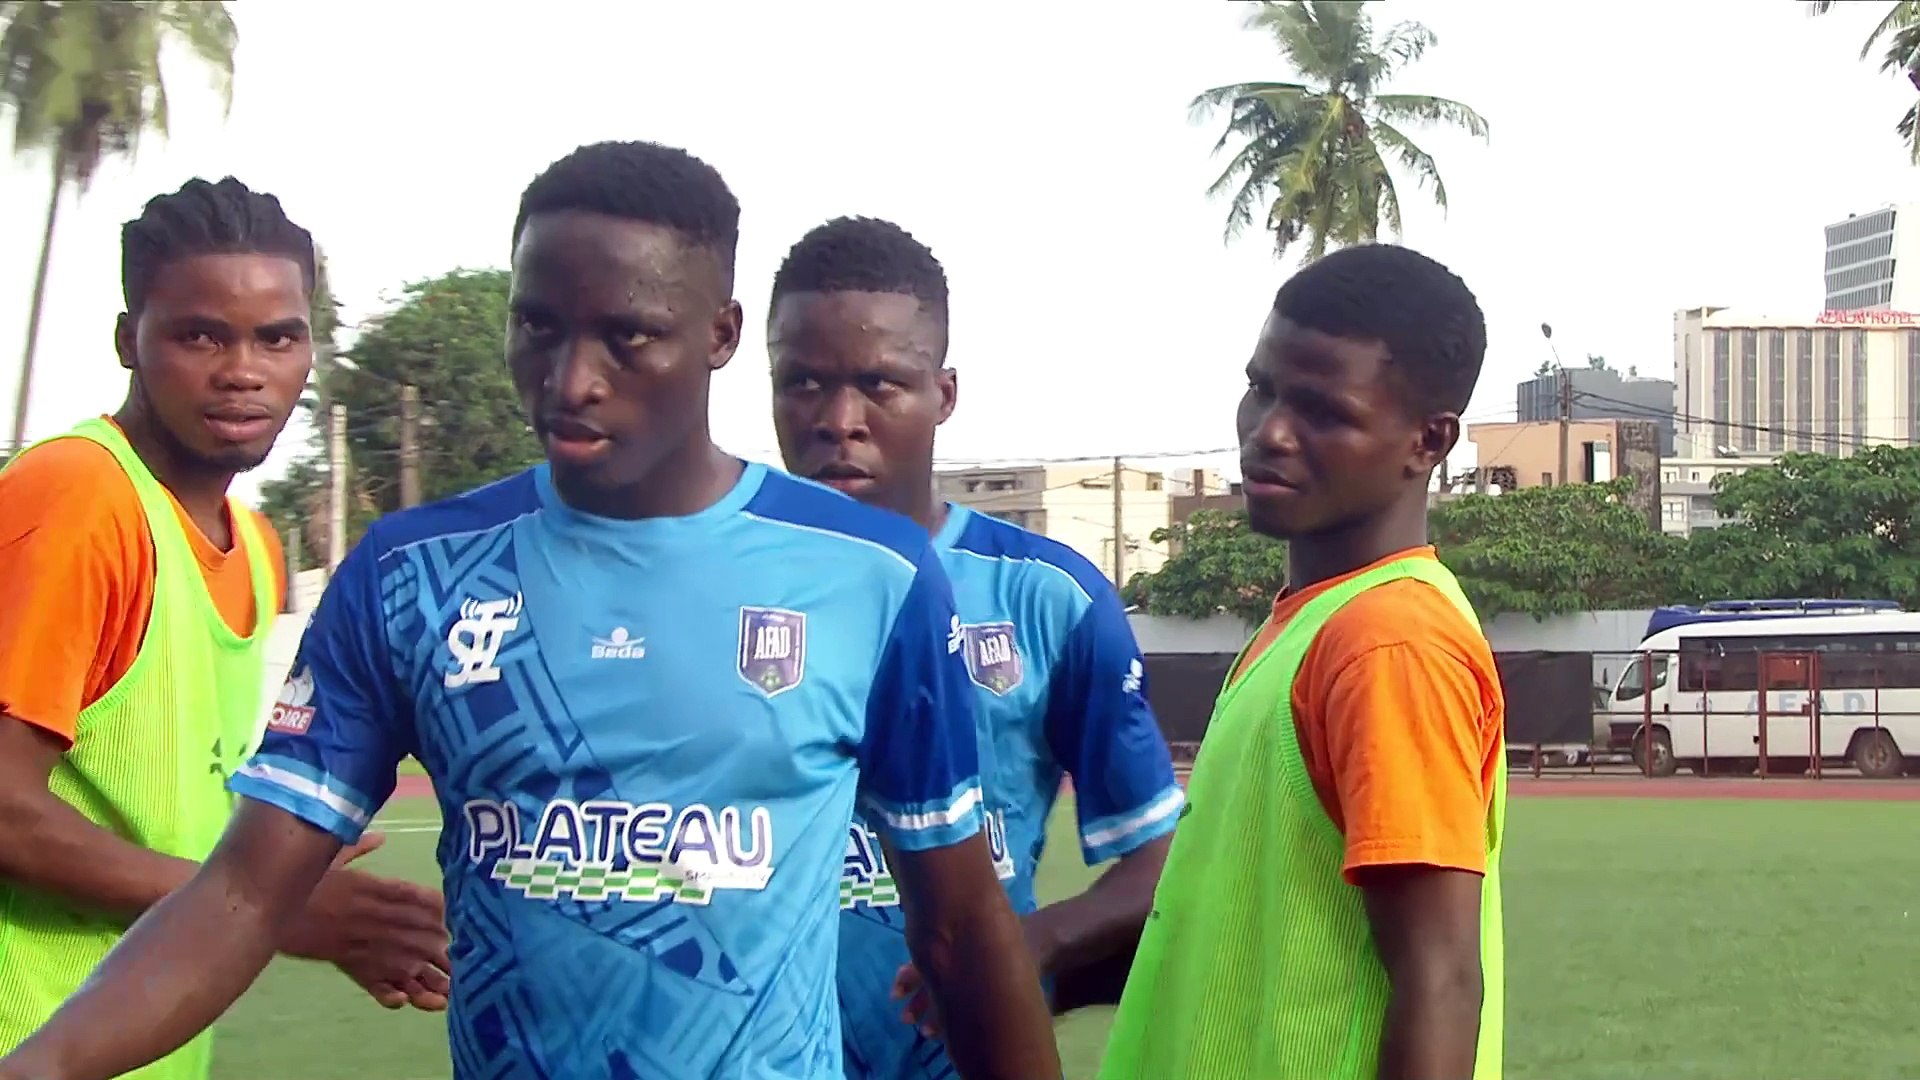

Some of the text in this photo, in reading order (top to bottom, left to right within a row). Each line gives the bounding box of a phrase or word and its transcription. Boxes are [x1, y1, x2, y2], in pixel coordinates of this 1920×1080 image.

[1871, 311, 1916, 324] HOTEL
[754, 626, 791, 660] AFAD
[467, 803, 768, 870] PLATEAU
